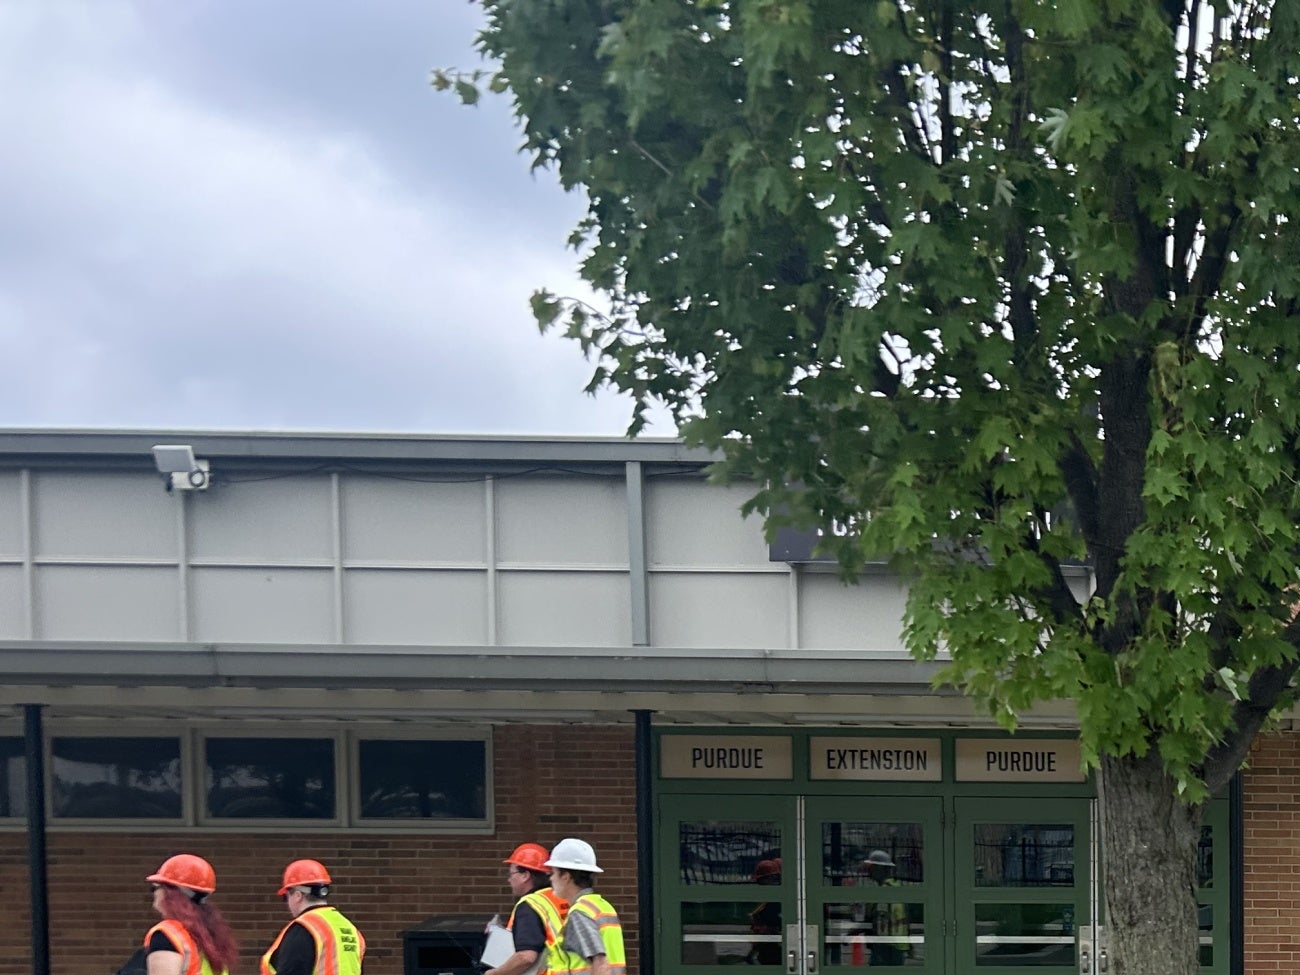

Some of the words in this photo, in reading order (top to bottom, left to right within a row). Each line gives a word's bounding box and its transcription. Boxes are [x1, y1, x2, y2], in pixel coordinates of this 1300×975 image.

[692, 747, 763, 769] PURDUE
[826, 749, 927, 770] EXTENSION
[986, 751, 1056, 772] PURDUE
